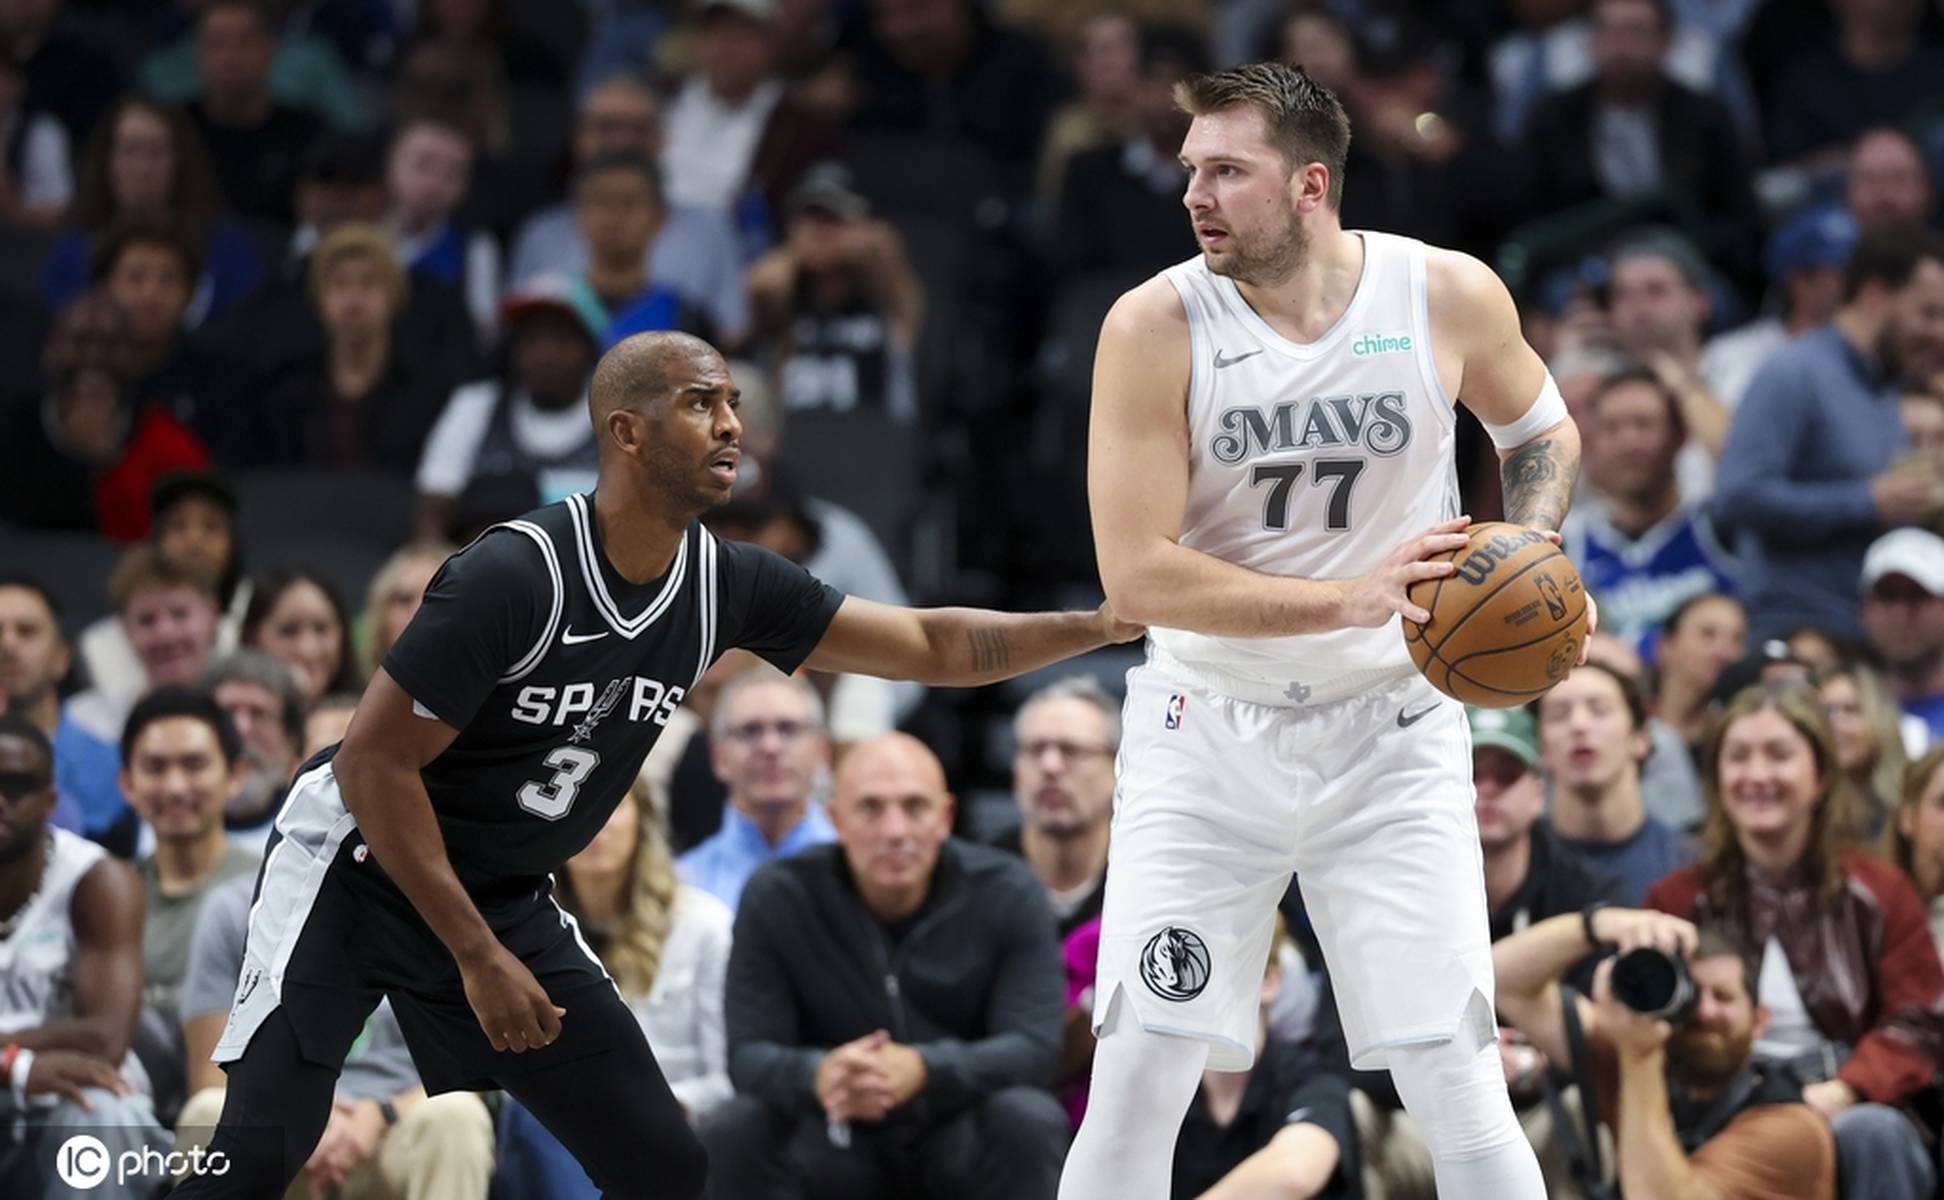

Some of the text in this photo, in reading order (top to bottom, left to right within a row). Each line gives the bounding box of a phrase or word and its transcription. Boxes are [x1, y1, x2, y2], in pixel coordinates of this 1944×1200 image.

[1353, 334, 1412, 355] chime
[1210, 391, 1413, 465] MAVS
[1250, 458, 1366, 532] 77
[1457, 530, 1548, 586] Wilson
[516, 746, 600, 821] 3
